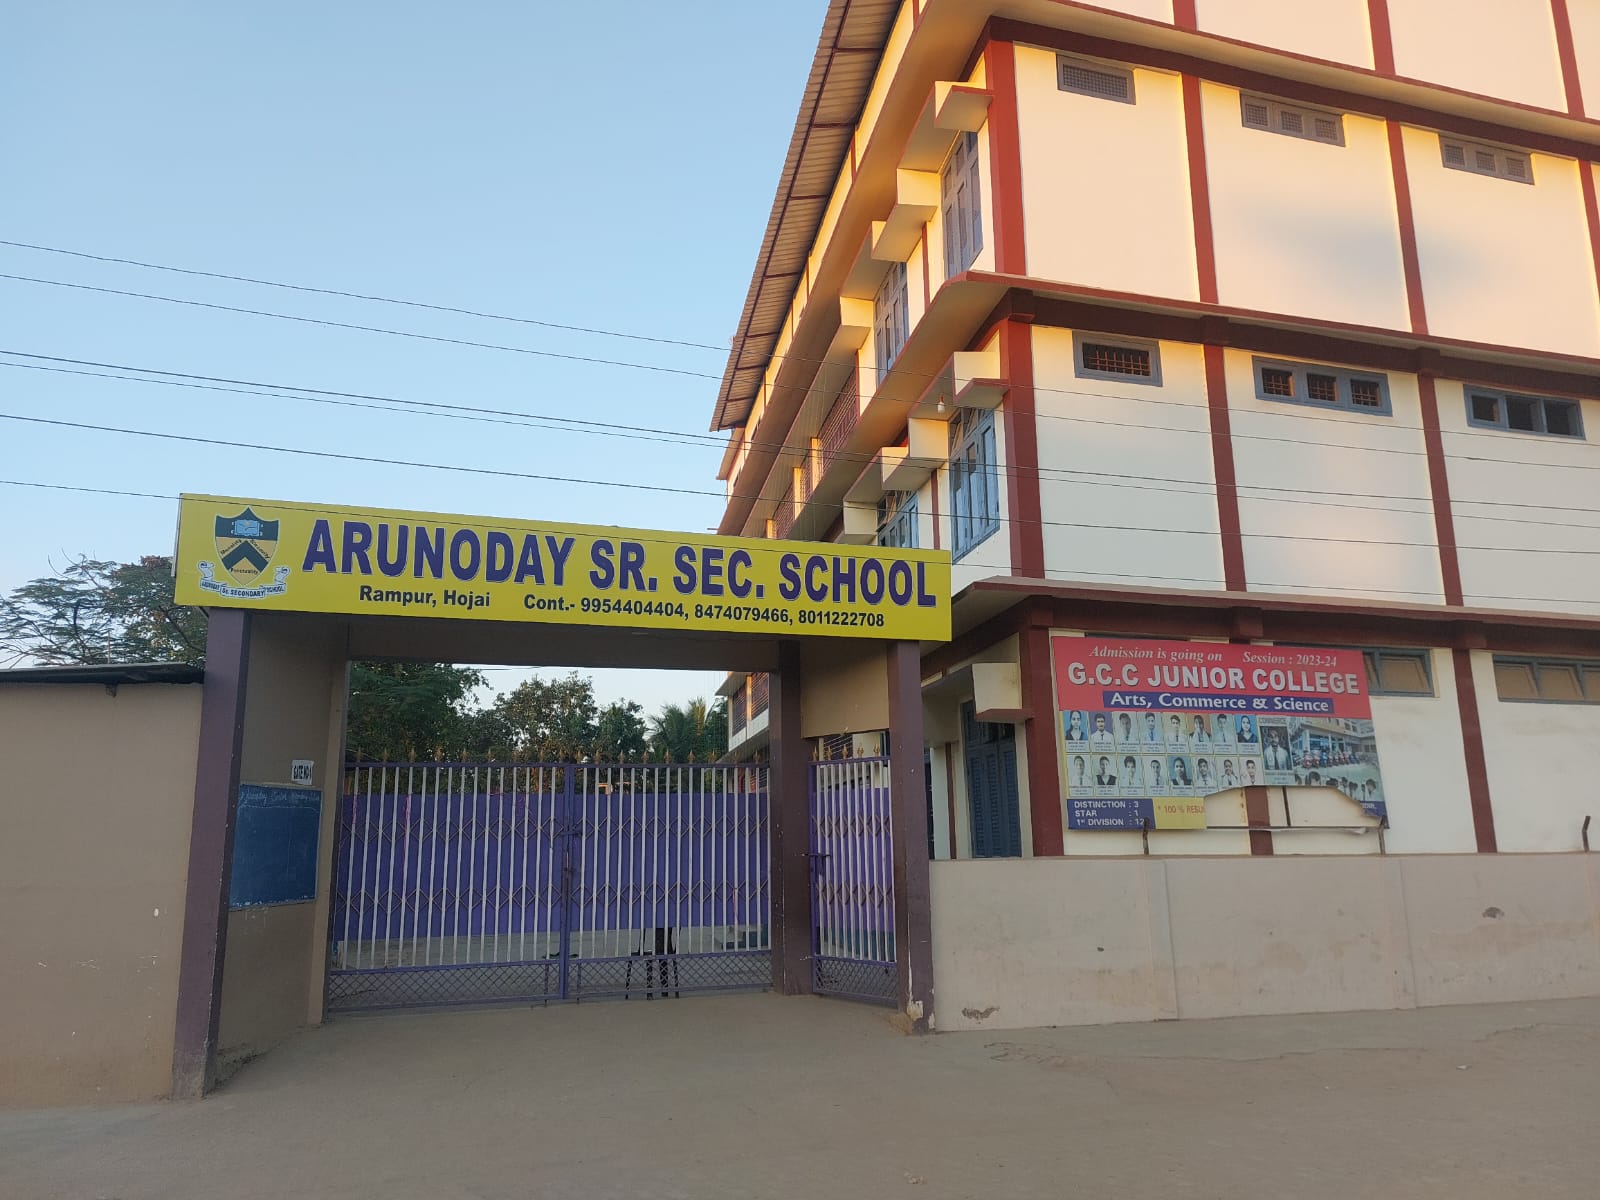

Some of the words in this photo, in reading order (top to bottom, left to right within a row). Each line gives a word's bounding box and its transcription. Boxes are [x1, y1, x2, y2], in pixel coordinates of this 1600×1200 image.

[302, 519, 576, 586] ARUNODAY
[590, 540, 657, 592] SR.
[673, 546, 764, 598] SEC.
[779, 553, 937, 607] SCHOOL
[360, 585, 436, 608] Rampur,
[443, 590, 490, 609] Hojai
[580, 597, 689, 620] 9954404404,
[694, 603, 793, 625] 8474079466,
[798, 609, 885, 627] 8011222708
[1089, 646, 1153, 659] Admission
[1157, 647, 1167, 659] is
[1170, 649, 1204, 664] going
[1207, 652, 1223, 662] on
[1242, 651, 1285, 664] Session
[1296, 654, 1337, 667] 2023-24
[1068, 661, 1139, 686] G.C.C
[1147, 665, 1246, 690] JUNIOR
[1252, 668, 1361, 694] COLLEGE
[1110, 692, 1152, 709] Arts,
[1158, 693, 1246, 709] Commerce
[1252, 697, 1269, 710] &
[1273, 697, 1329, 712] Science
[1074, 801, 1126, 809] DISTINCTION
[1074, 809, 1098, 817] STAR
[1088, 818, 1124, 826] DIVISION
